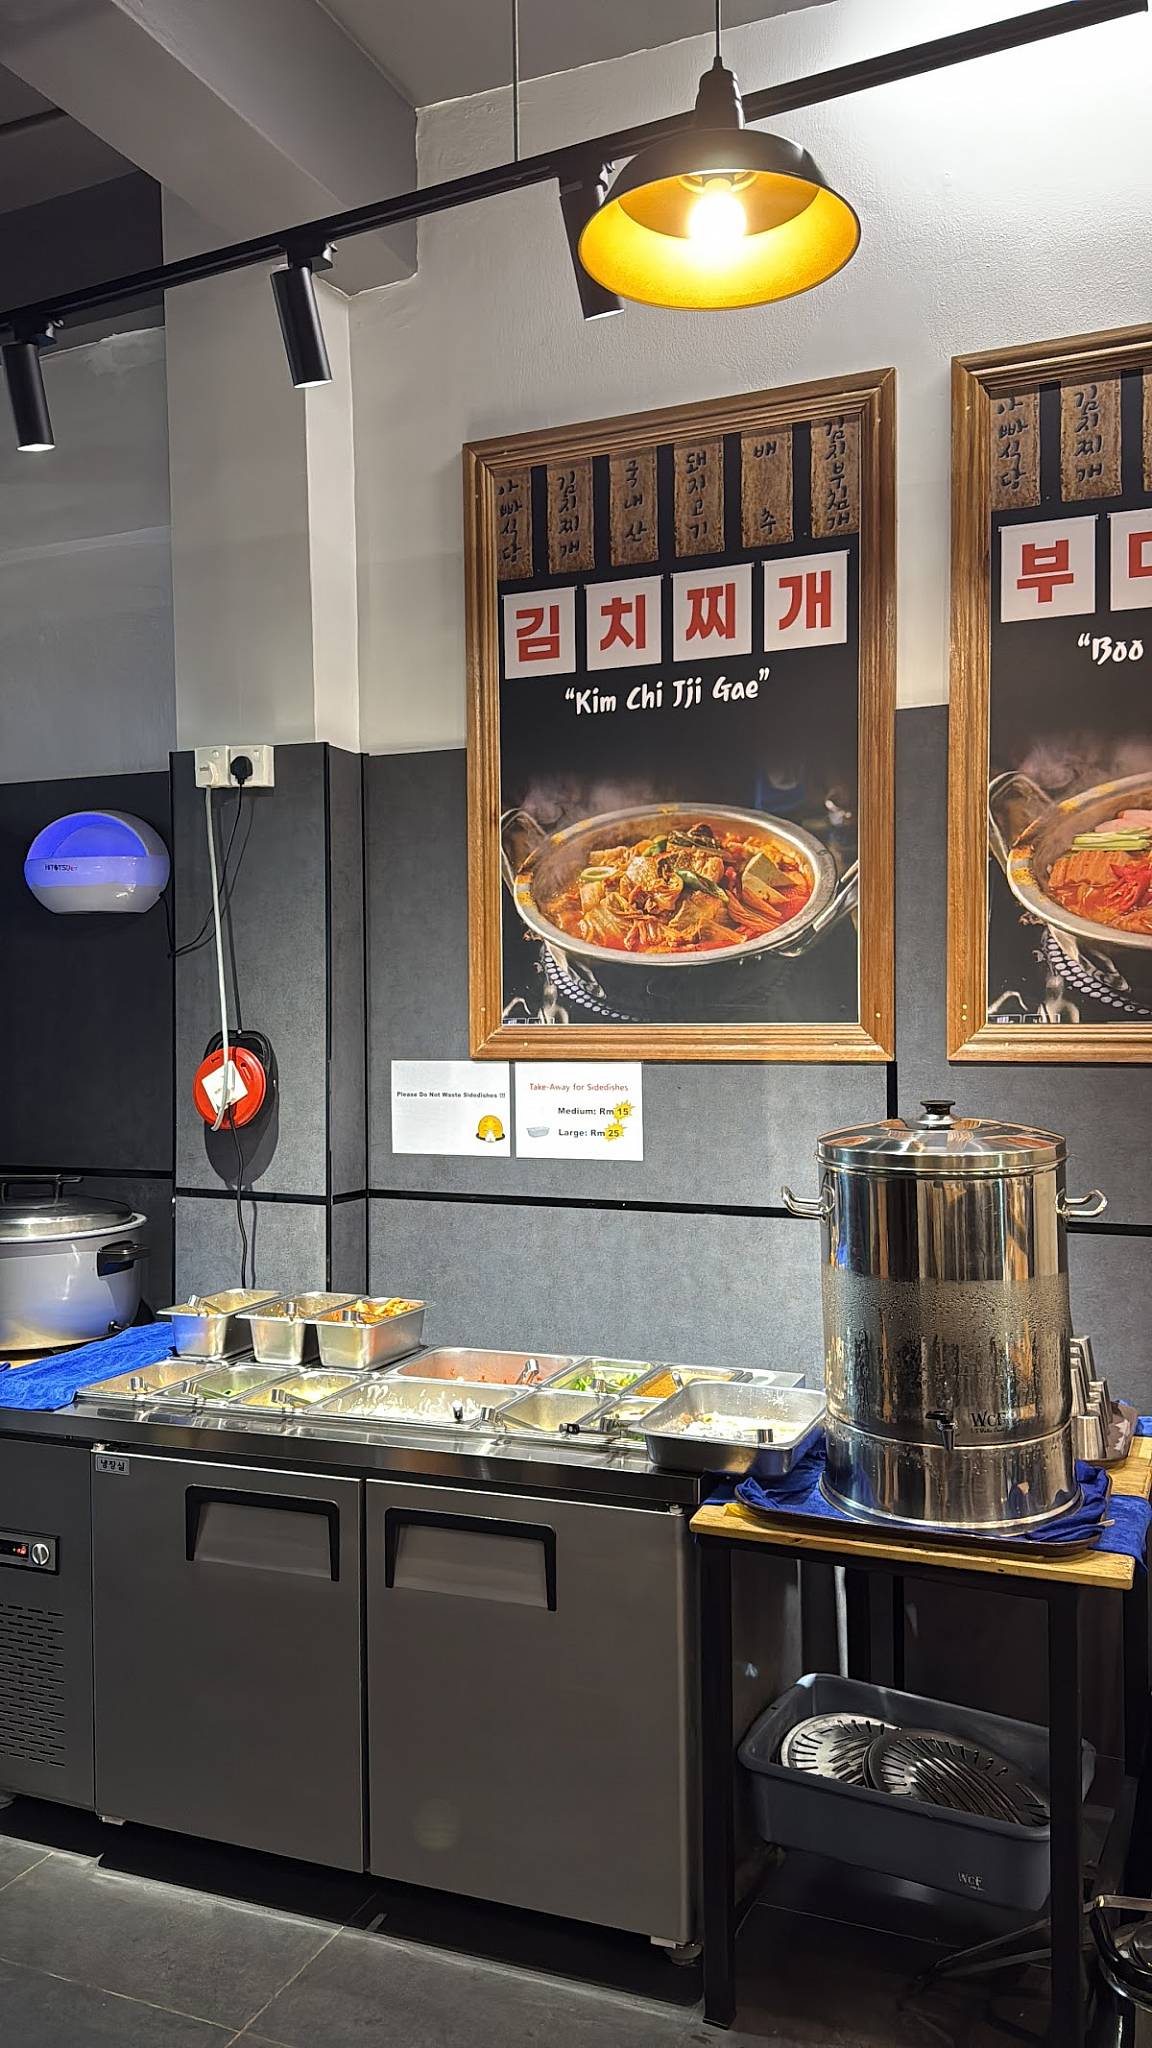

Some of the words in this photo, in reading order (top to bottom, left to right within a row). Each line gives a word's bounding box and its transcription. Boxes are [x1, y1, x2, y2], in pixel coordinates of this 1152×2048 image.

[626, 680, 663, 711] Chi
[672, 676, 702, 709] Jji
[529, 1083, 570, 1092] Take-Away
[573, 1083, 585, 1092] for
[587, 1083, 629, 1092] Sidedishes
[557, 1107, 597, 1116] Medium:
[599, 1107, 615, 1115] Rm
[617, 1107, 629, 1116] 15
[558, 1129, 588, 1138] Large:
[590, 1129, 606, 1137] Rm
[608, 1129, 620, 1137] 25
